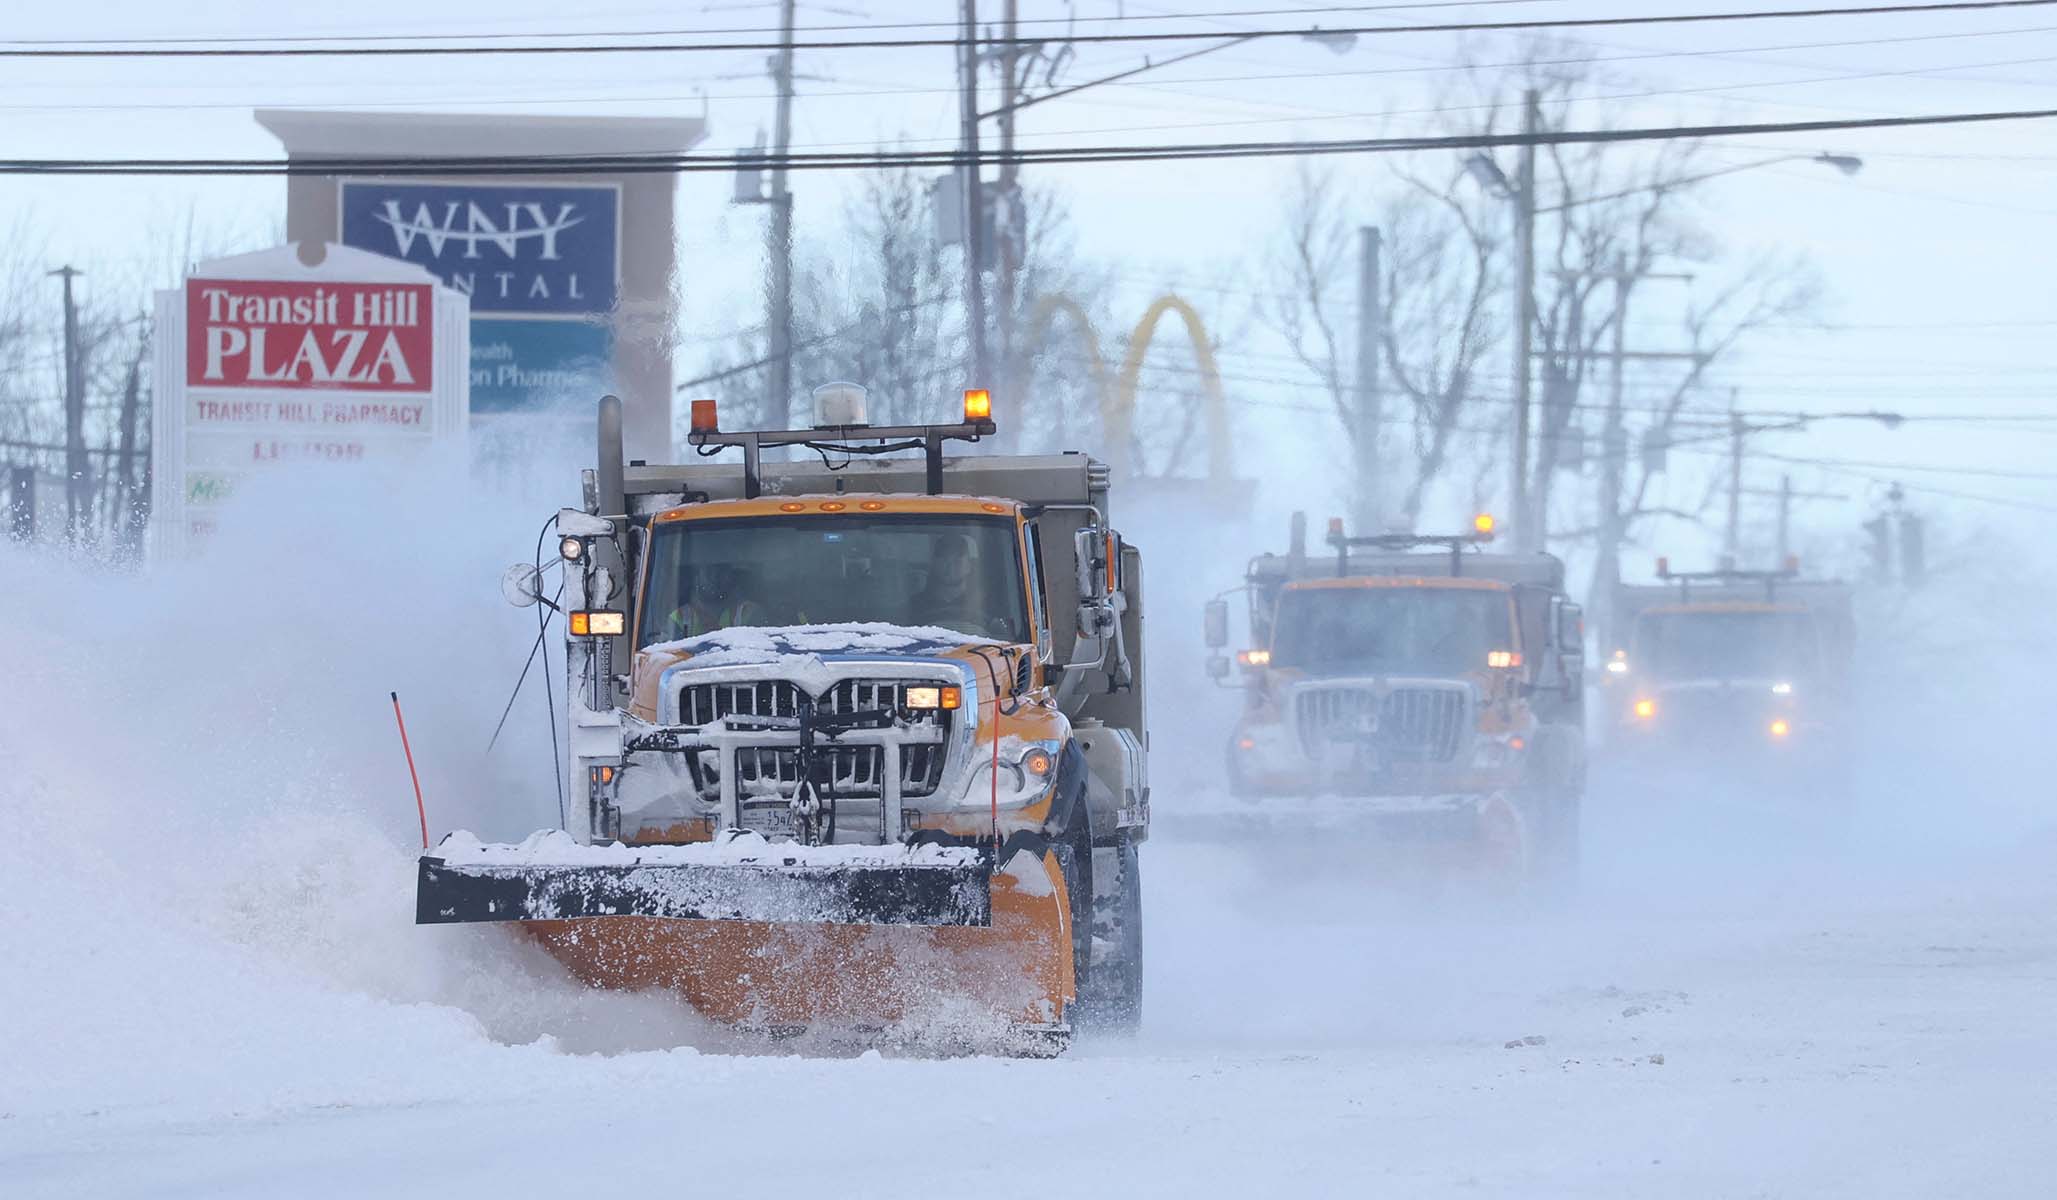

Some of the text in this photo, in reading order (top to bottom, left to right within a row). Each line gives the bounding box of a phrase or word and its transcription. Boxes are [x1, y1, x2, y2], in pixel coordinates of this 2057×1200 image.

[384, 200, 577, 260] WNY
[453, 272, 584, 299] NTAL
[203, 288, 417, 326] Transit Hill
[203, 325, 415, 384] PLAZA
[471, 341, 512, 360] ealth
[471, 368, 491, 387] on
[197, 402, 423, 425] TRANSIT HILL PHARMACY
